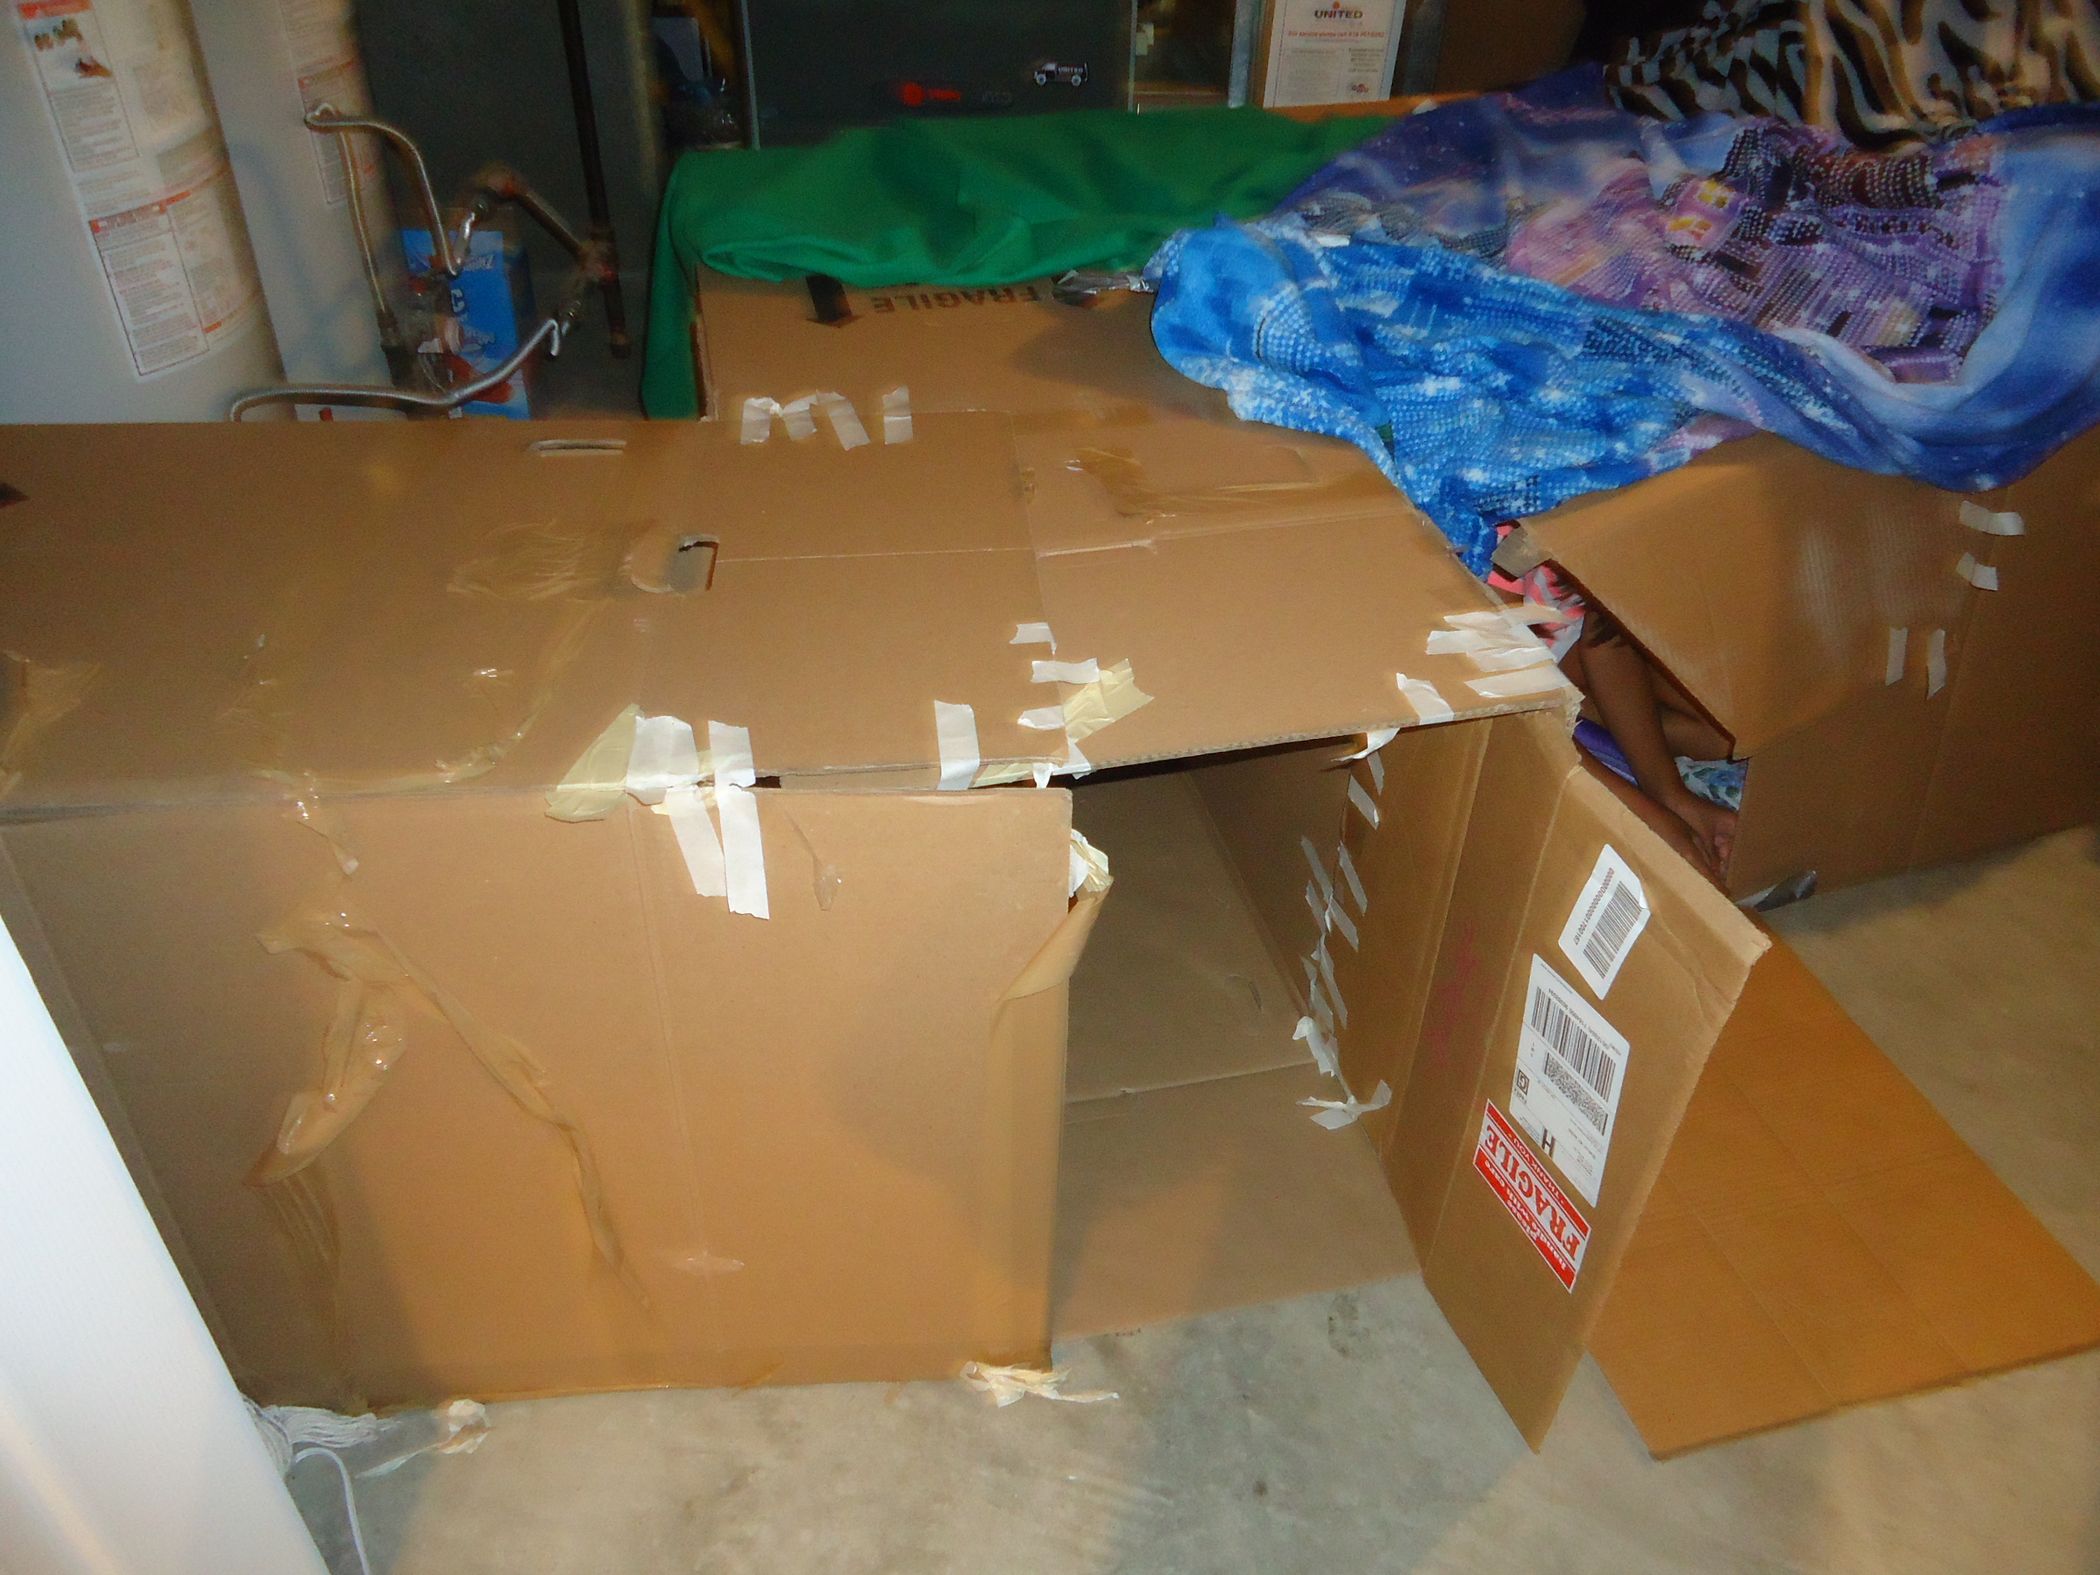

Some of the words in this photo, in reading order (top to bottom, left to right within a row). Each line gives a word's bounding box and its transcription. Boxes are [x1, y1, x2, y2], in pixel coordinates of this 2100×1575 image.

[1314, 9, 1363, 19] UNITED
[1513, 1137, 1531, 1164] YOU
[1541, 1128, 1556, 1158] H
[1484, 1159, 1506, 1189] care
[1531, 1162, 1561, 1200] THANK
[1484, 1124, 1581, 1262] FRAGILE
[1506, 1185, 1530, 1220] with
